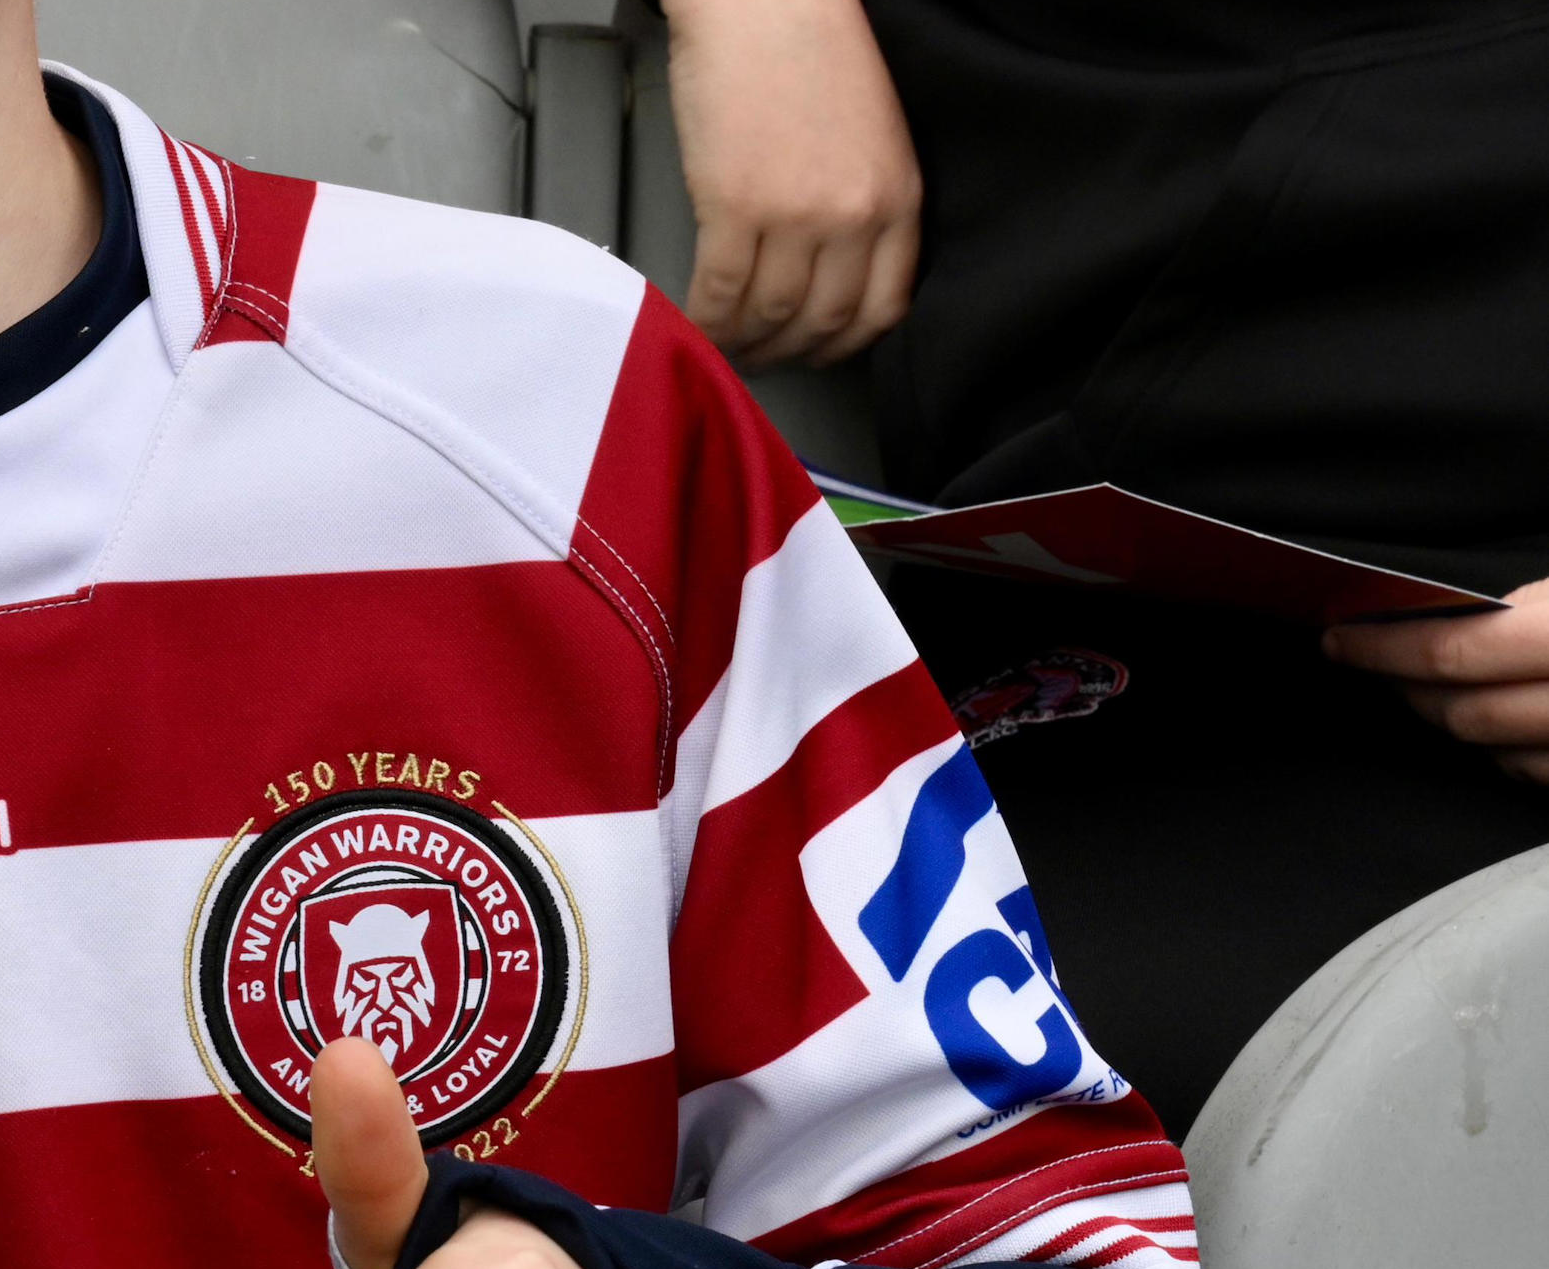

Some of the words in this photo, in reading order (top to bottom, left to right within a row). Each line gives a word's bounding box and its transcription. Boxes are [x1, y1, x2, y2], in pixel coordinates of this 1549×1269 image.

[264, 761, 336, 814] 150
[347, 752, 481, 800] YEARS
[240, 842, 330, 963] WIGAN
[332, 823, 520, 936] WARRIORS
[497, 950, 530, 972] 72
[237, 981, 266, 1003] 18
[431, 1034, 508, 1104] LOYAL
[454, 1118, 520, 1163] 022
